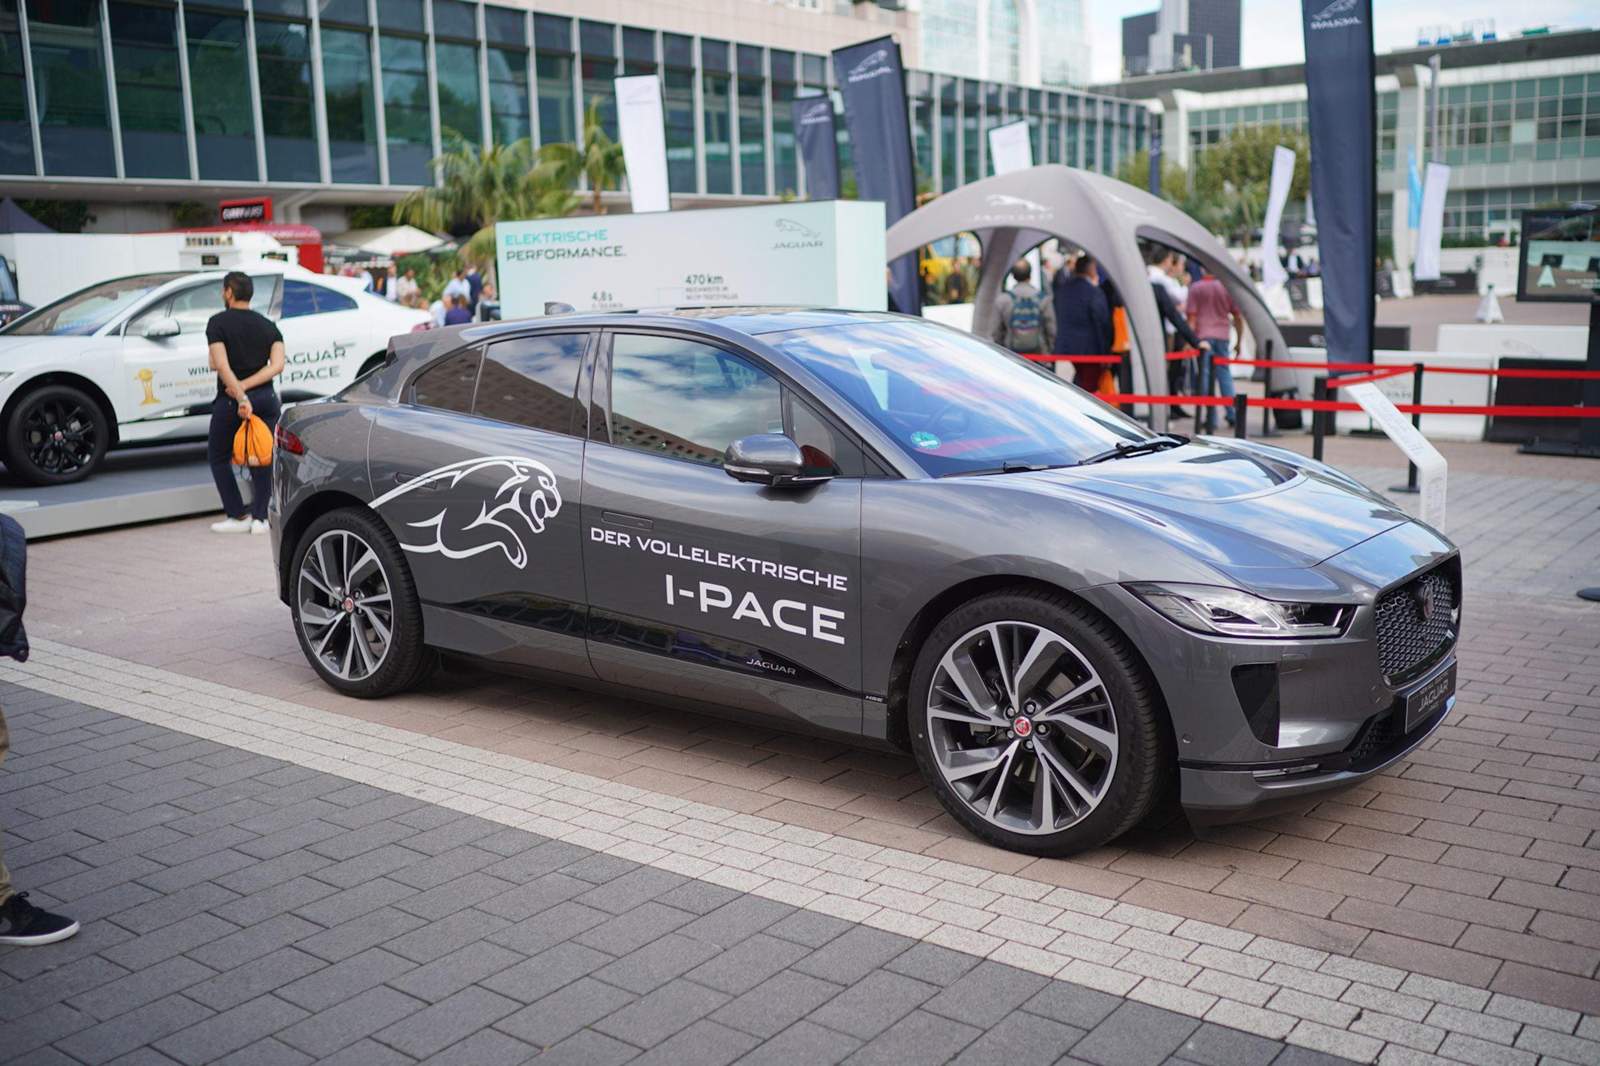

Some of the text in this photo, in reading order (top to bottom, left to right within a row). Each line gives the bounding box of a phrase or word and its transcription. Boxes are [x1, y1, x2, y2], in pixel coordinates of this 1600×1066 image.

[505, 229, 608, 246] ELEKTRISCHE
[772, 240, 824, 250] JAGUAR
[506, 245, 627, 261] PERFORMANCE.
[686, 274, 724, 285] 470 km
[284, 346, 346, 364] AGUAR
[279, 366, 340, 383] I-PACE
[590, 527, 848, 592] DER VOLLELEKTRISCHE
[665, 574, 846, 645] I-PACE
[746, 658, 796, 676] JAGUAR
[1417, 678, 1449, 713] JAGUAR
